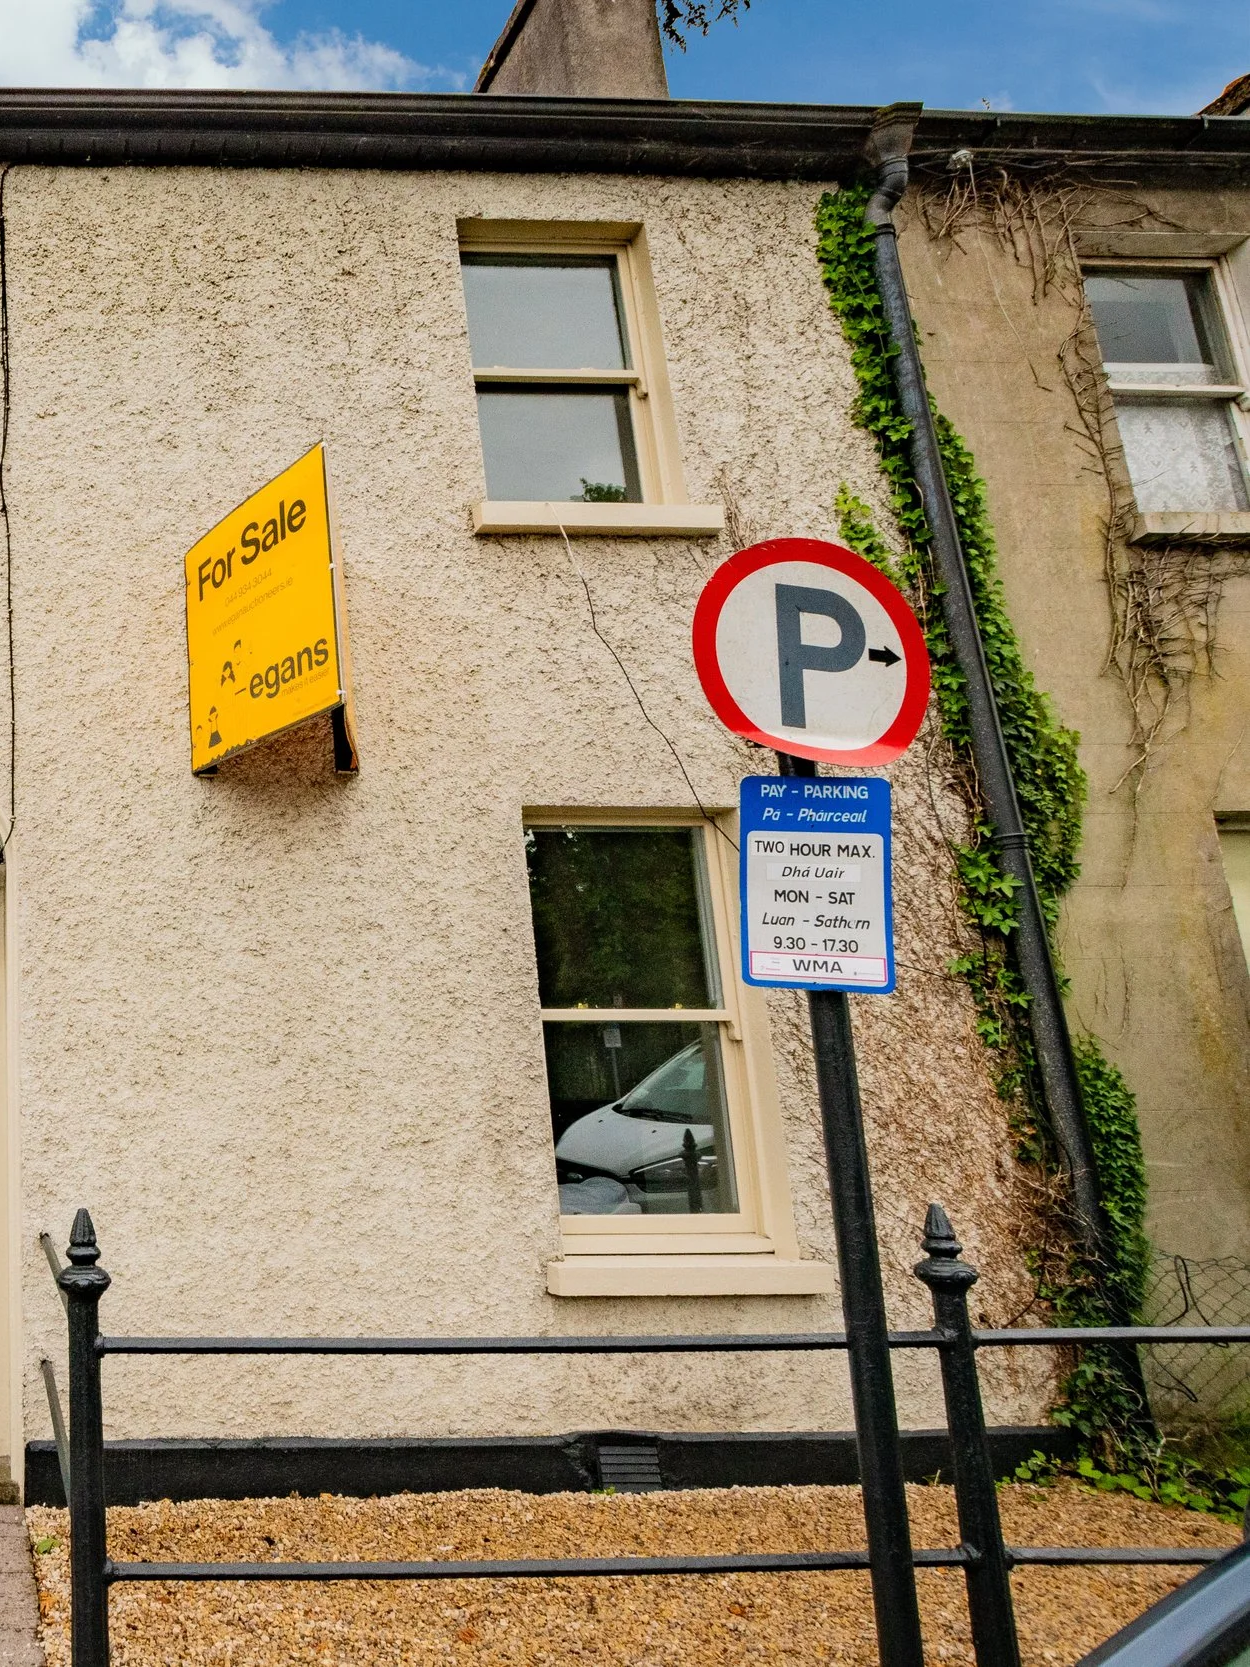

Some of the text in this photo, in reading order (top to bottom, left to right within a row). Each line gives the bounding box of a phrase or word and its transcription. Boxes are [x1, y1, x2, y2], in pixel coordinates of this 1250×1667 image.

[198, 499, 307, 602] For Sale
[775, 583, 866, 729] P
[250, 638, 329, 699] egans
[760, 784, 787, 797] PAY
[804, 785, 869, 799] PARKING
[755, 840, 875, 859] TWO HOUR MAX.
[782, 866, 845, 879] Dhá Uair
[774, 890, 809, 903] MON
[828, 891, 855, 905] SAT
[762, 912, 795, 926] Luan
[773, 936, 806, 950] 9.30
[822, 938, 859, 953] 17.30
[792, 959, 843, 974] WMA
